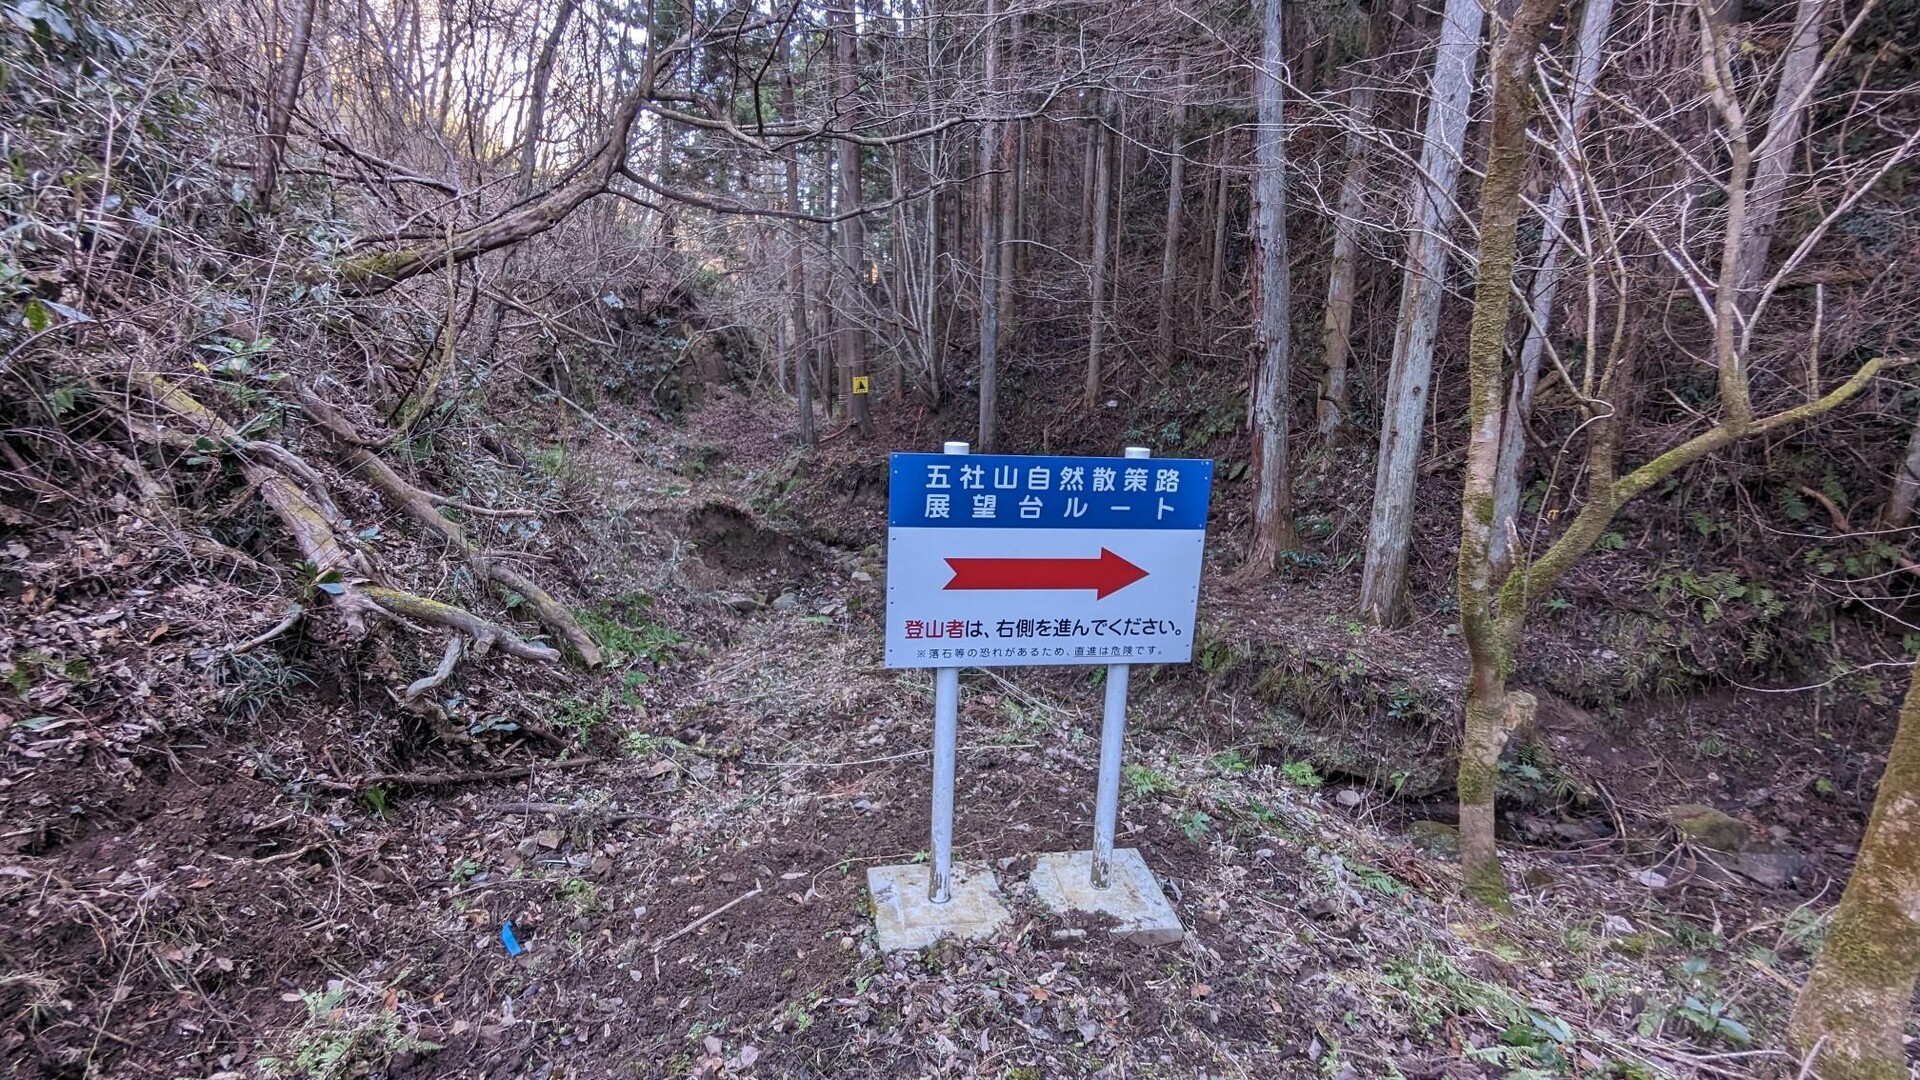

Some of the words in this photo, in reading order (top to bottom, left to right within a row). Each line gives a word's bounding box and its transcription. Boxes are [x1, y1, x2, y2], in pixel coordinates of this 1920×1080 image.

[925, 464, 1180, 493] 五社山自然散策路
[924, 494, 1175, 520] 展望台ルート
[904, 618, 1182, 639] 登山者は、右側を進んでください。
